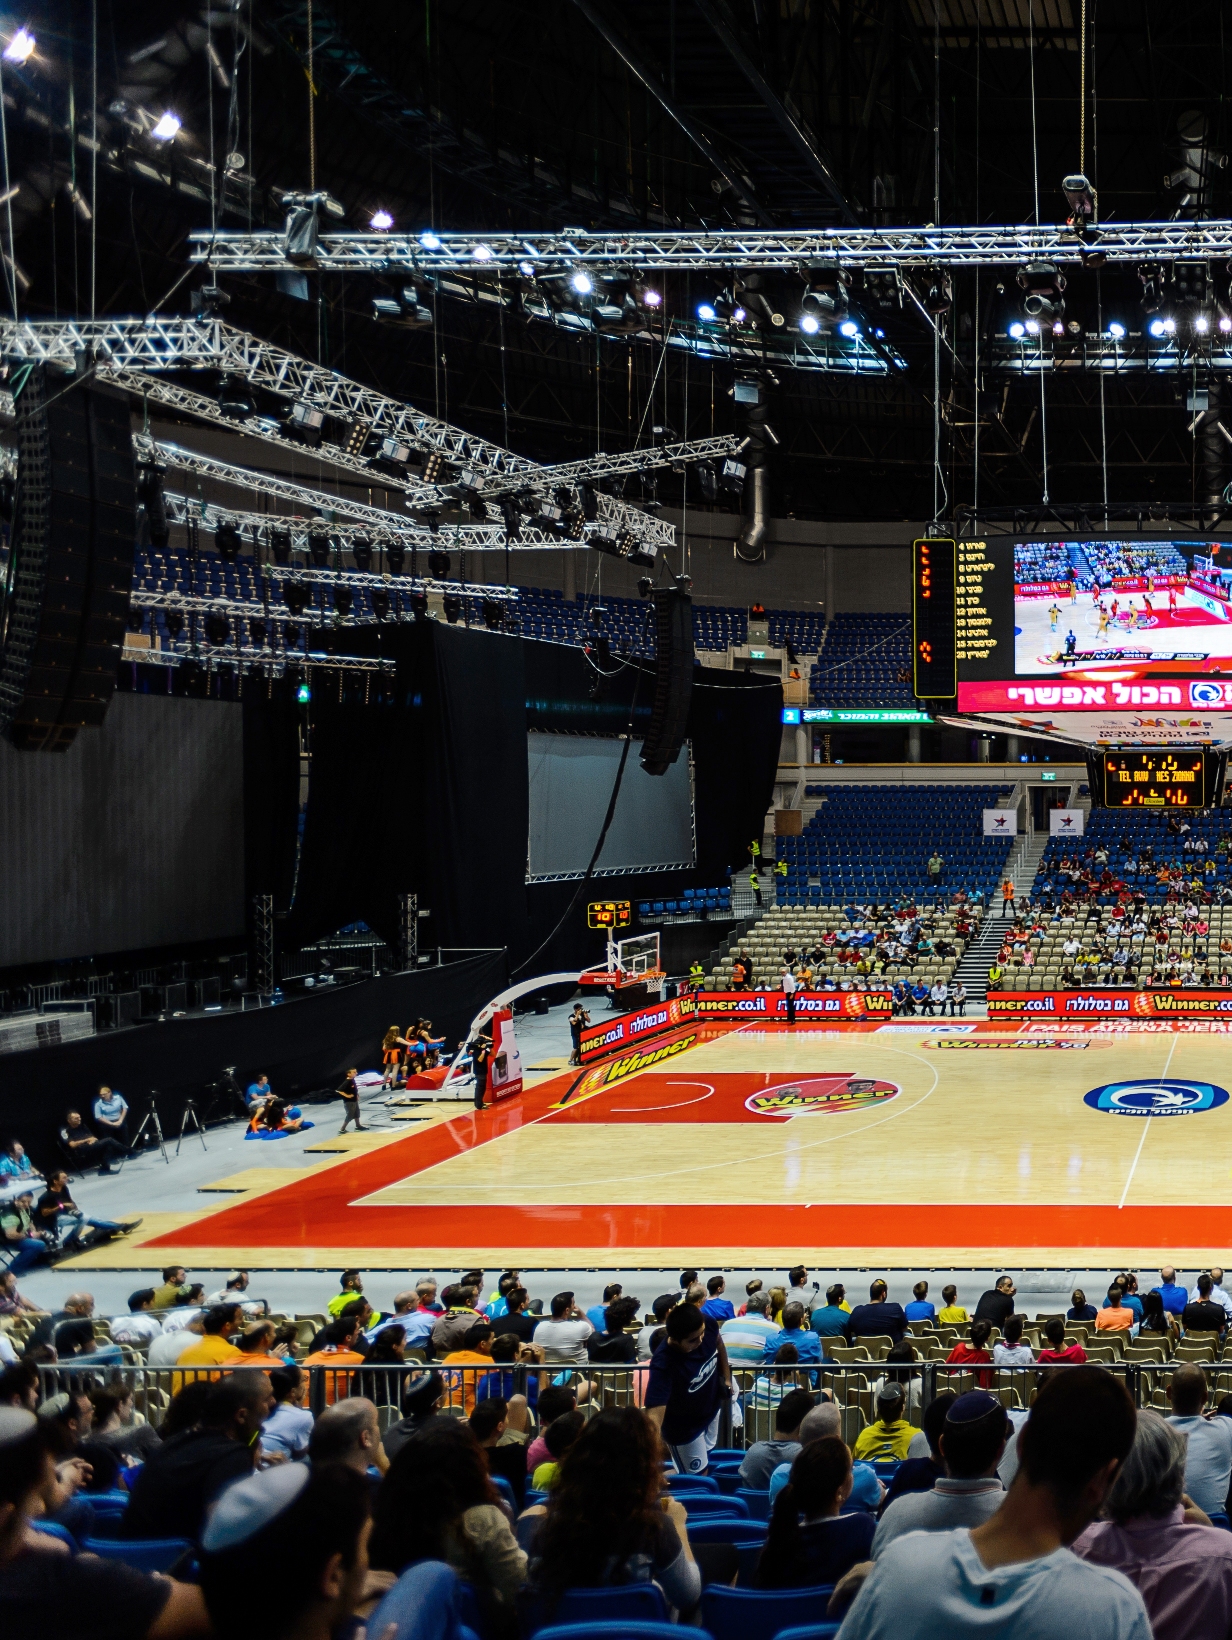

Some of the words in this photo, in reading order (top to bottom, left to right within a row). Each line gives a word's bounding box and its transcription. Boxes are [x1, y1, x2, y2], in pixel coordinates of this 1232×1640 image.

[957, 597, 965, 605] 11
[957, 608, 966, 616] 12
[1008, 685, 1106, 705] אפשרי
[1112, 682, 1181, 705] הכול
[786, 712, 794, 720] 2
[1118, 771, 1131, 782] TEL
[1134, 771, 1149, 782] AVIV
[1156, 771, 1169, 782] NES
[777, 998, 822, 1011] בסלור!
[825, 999, 840, 1011] גם
[1066, 996, 1111, 1011] בסלולר!
[1114, 999, 1129, 1011] גם
[656, 1011, 667, 1024] גם
[938, 1041, 1056, 1049] Winner
[606, 1035, 697, 1081] Winner
[755, 1090, 894, 1107] Winner
